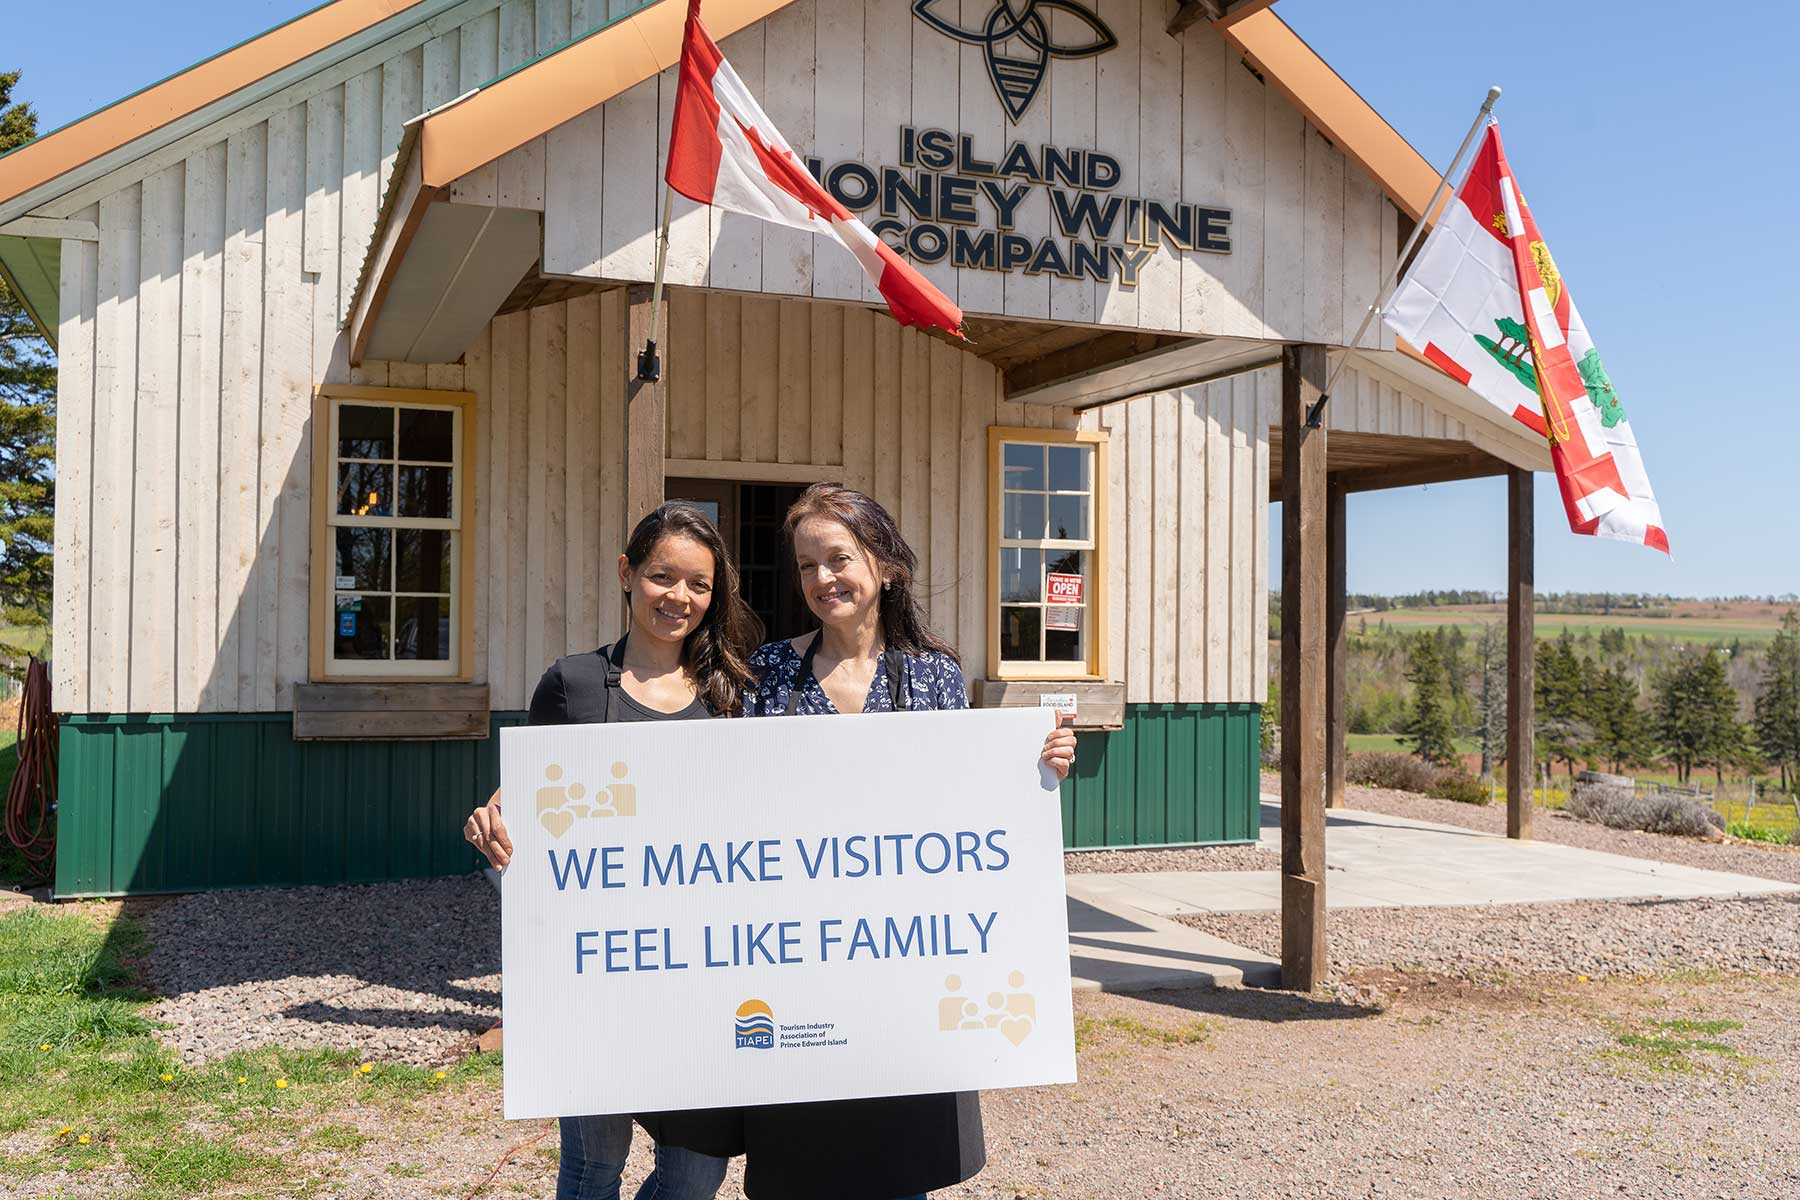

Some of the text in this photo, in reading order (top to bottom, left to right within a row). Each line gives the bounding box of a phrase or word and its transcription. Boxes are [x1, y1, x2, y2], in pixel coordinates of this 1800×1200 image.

[901, 124, 1122, 192] ISLAND
[803, 154, 1233, 255] ONEY WINE
[869, 217, 1155, 287] COMPANY
[1053, 582, 1079, 596] OPEN
[548, 829, 1010, 892] WE MAKE VISITORS
[575, 911, 998, 975] FEEL LIKE FAMILY
[737, 1035, 773, 1046] TIAPEI
[780, 1032, 818, 1040] Association
[827, 1038, 848, 1046] Island
